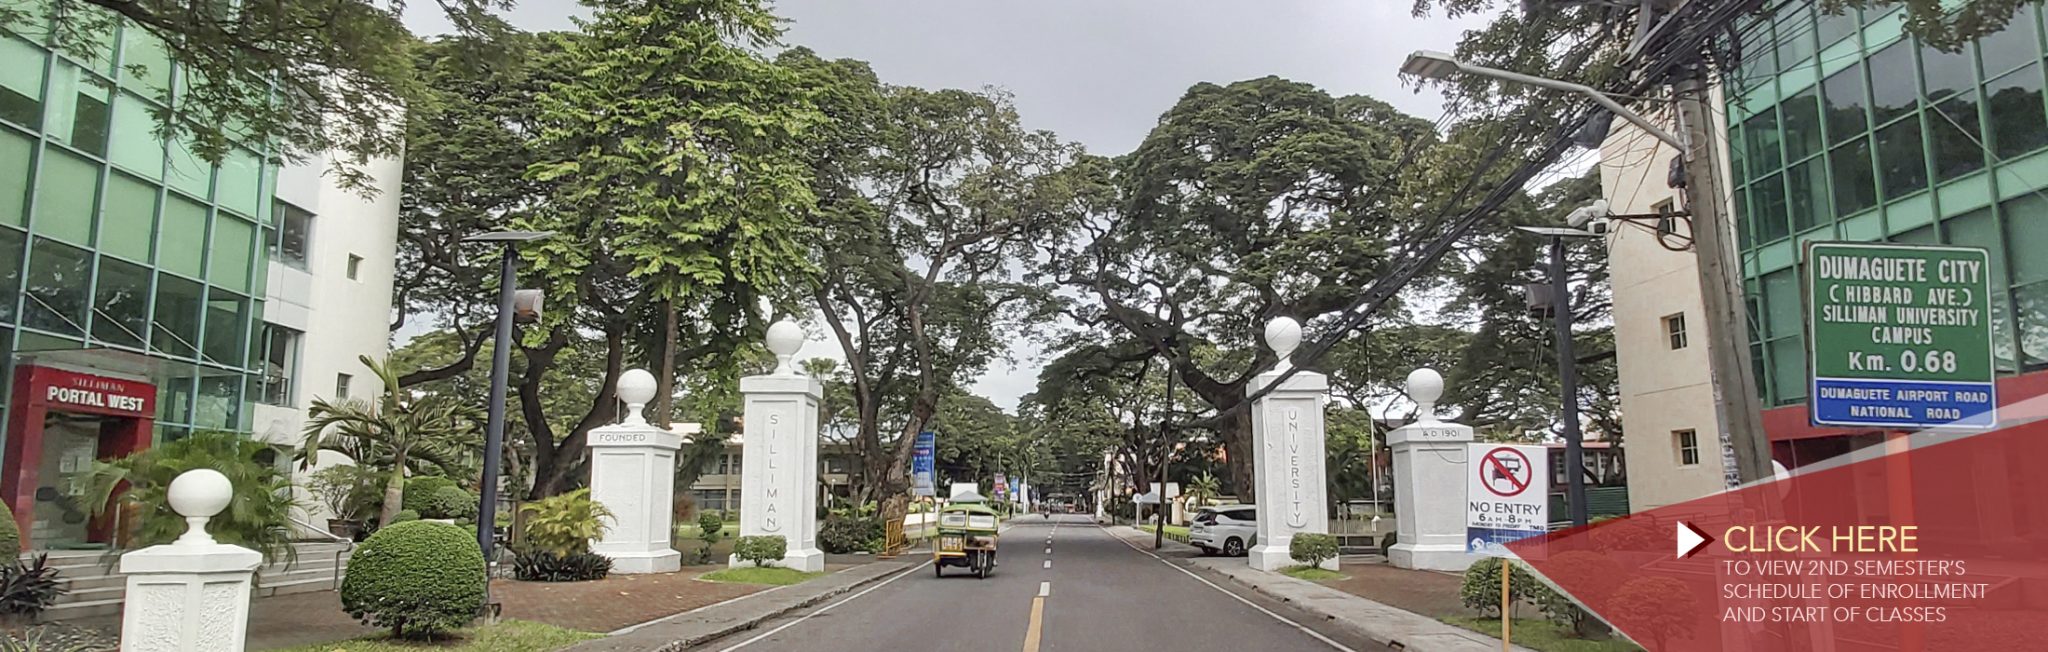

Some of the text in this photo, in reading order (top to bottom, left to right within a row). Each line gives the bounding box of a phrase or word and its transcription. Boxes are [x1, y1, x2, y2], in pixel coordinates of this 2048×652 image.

[1819, 255, 1981, 284] DUMAGUETE CITY
[1823, 304, 1979, 326] SILLIMAN UNIVERSITY
[1871, 326, 1932, 345] CAMPUS
[1848, 350, 1957, 373] Km. 0.68
[72, 377, 126, 393] SILLIMAN
[1820, 386, 1988, 404] DUMAGUETE AIRPORT ROAD
[46, 385, 145, 412] PORTAL WEST
[1850, 405, 1961, 420] NATIONAL ROAD
[599, 433, 646, 442] FOUNDED
[766, 414, 779, 528] SILLIMAN
[1288, 410, 1301, 524] UNIVERSITY
[1469, 501, 1542, 516] NO ENTRY
